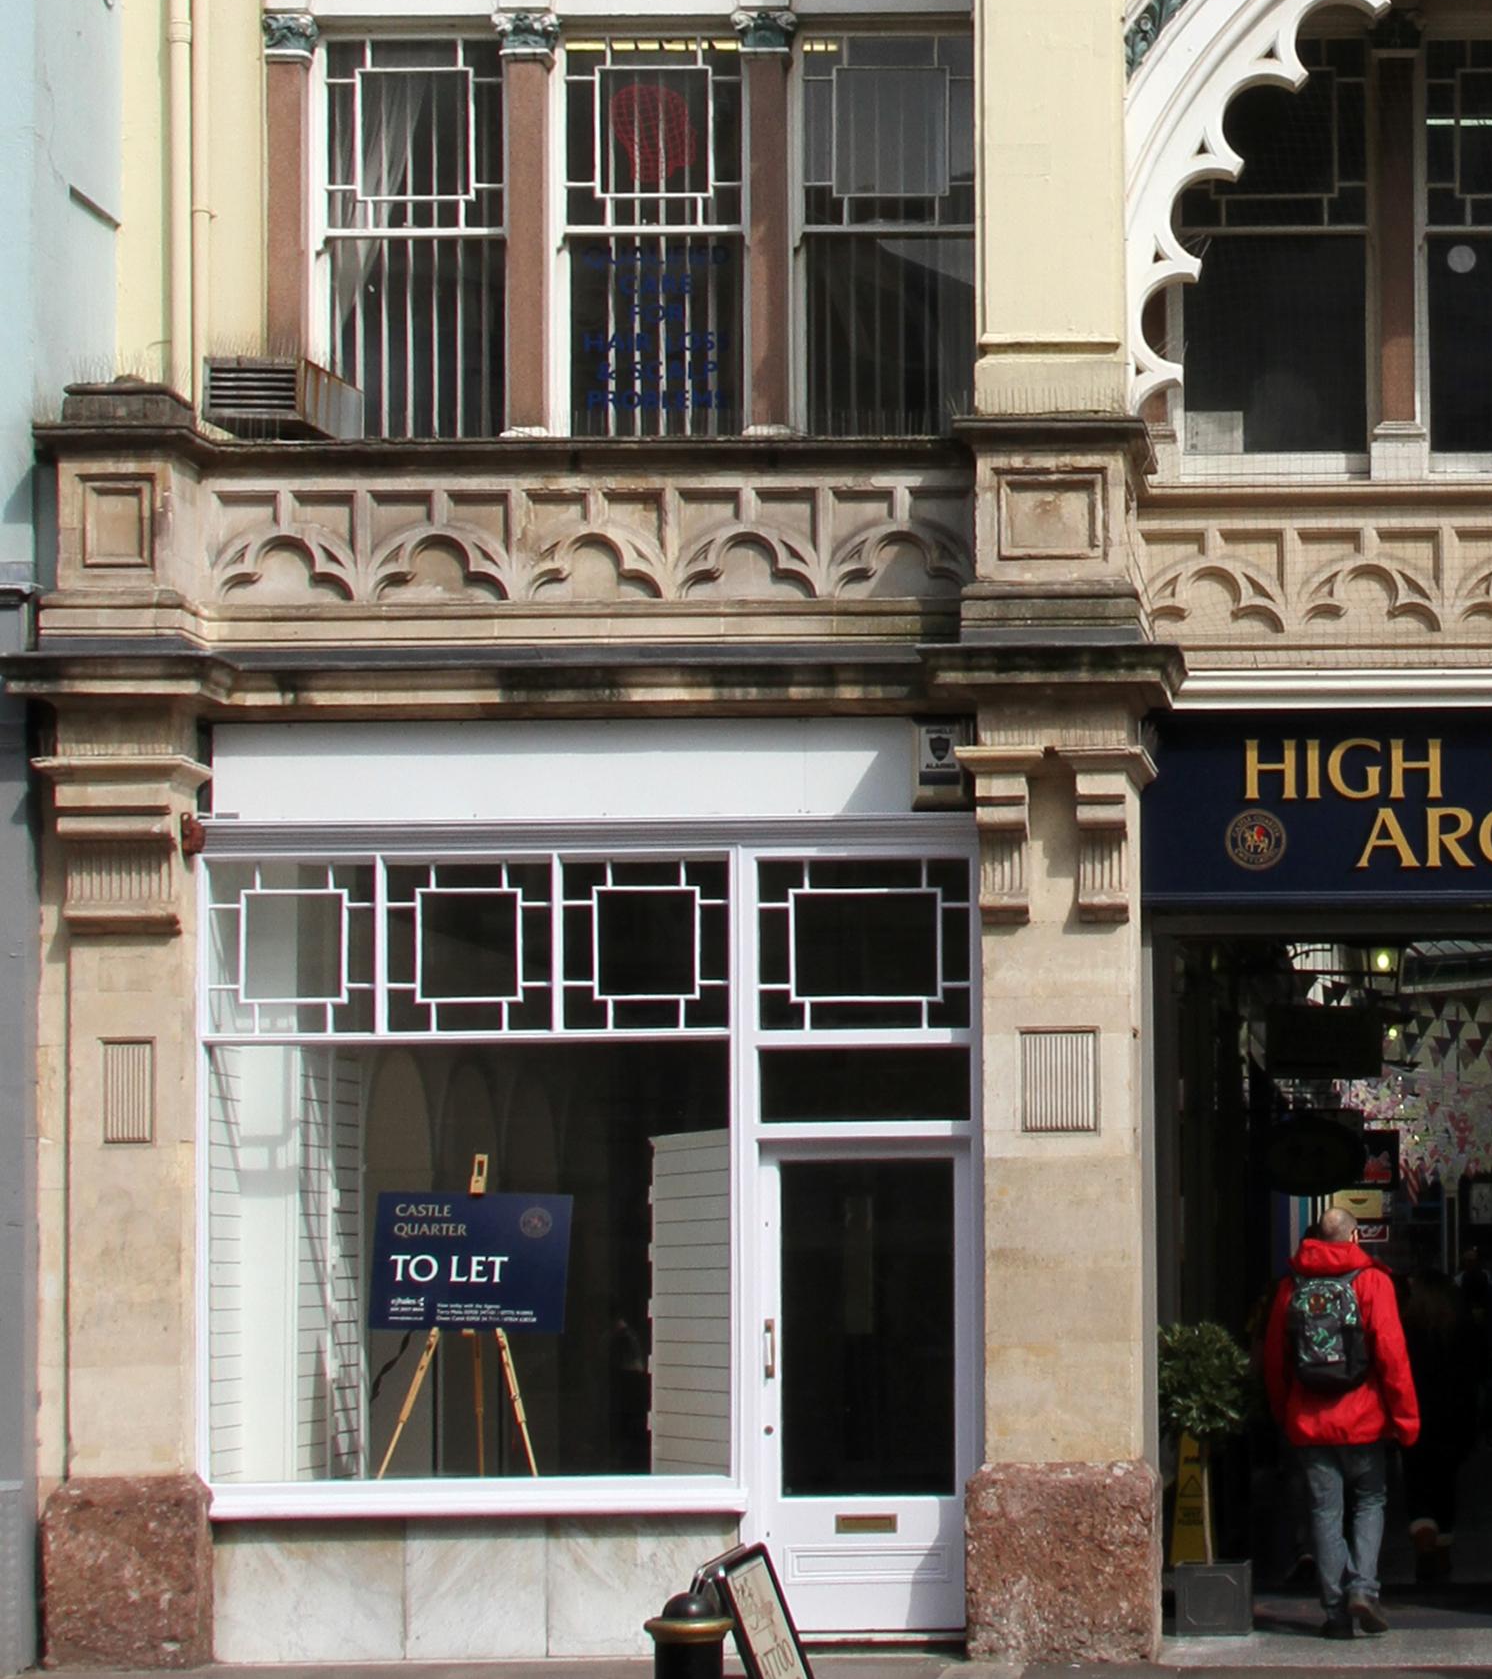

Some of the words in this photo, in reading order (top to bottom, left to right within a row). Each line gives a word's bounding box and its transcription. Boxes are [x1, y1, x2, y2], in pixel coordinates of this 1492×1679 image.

[620, 273, 692, 294] CARE
[629, 304, 684, 322] FOR
[583, 332, 650, 352] HAIR
[633, 361, 717, 380] SCALP
[586, 390, 727, 410] PROBLEMS
[1244, 738, 1443, 799] HIGH
[395, 1203, 451, 1217] CASTLE
[394, 1222, 468, 1237] QUARTER
[389, 1255, 439, 1282] TO
[449, 1255, 509, 1283] LET
